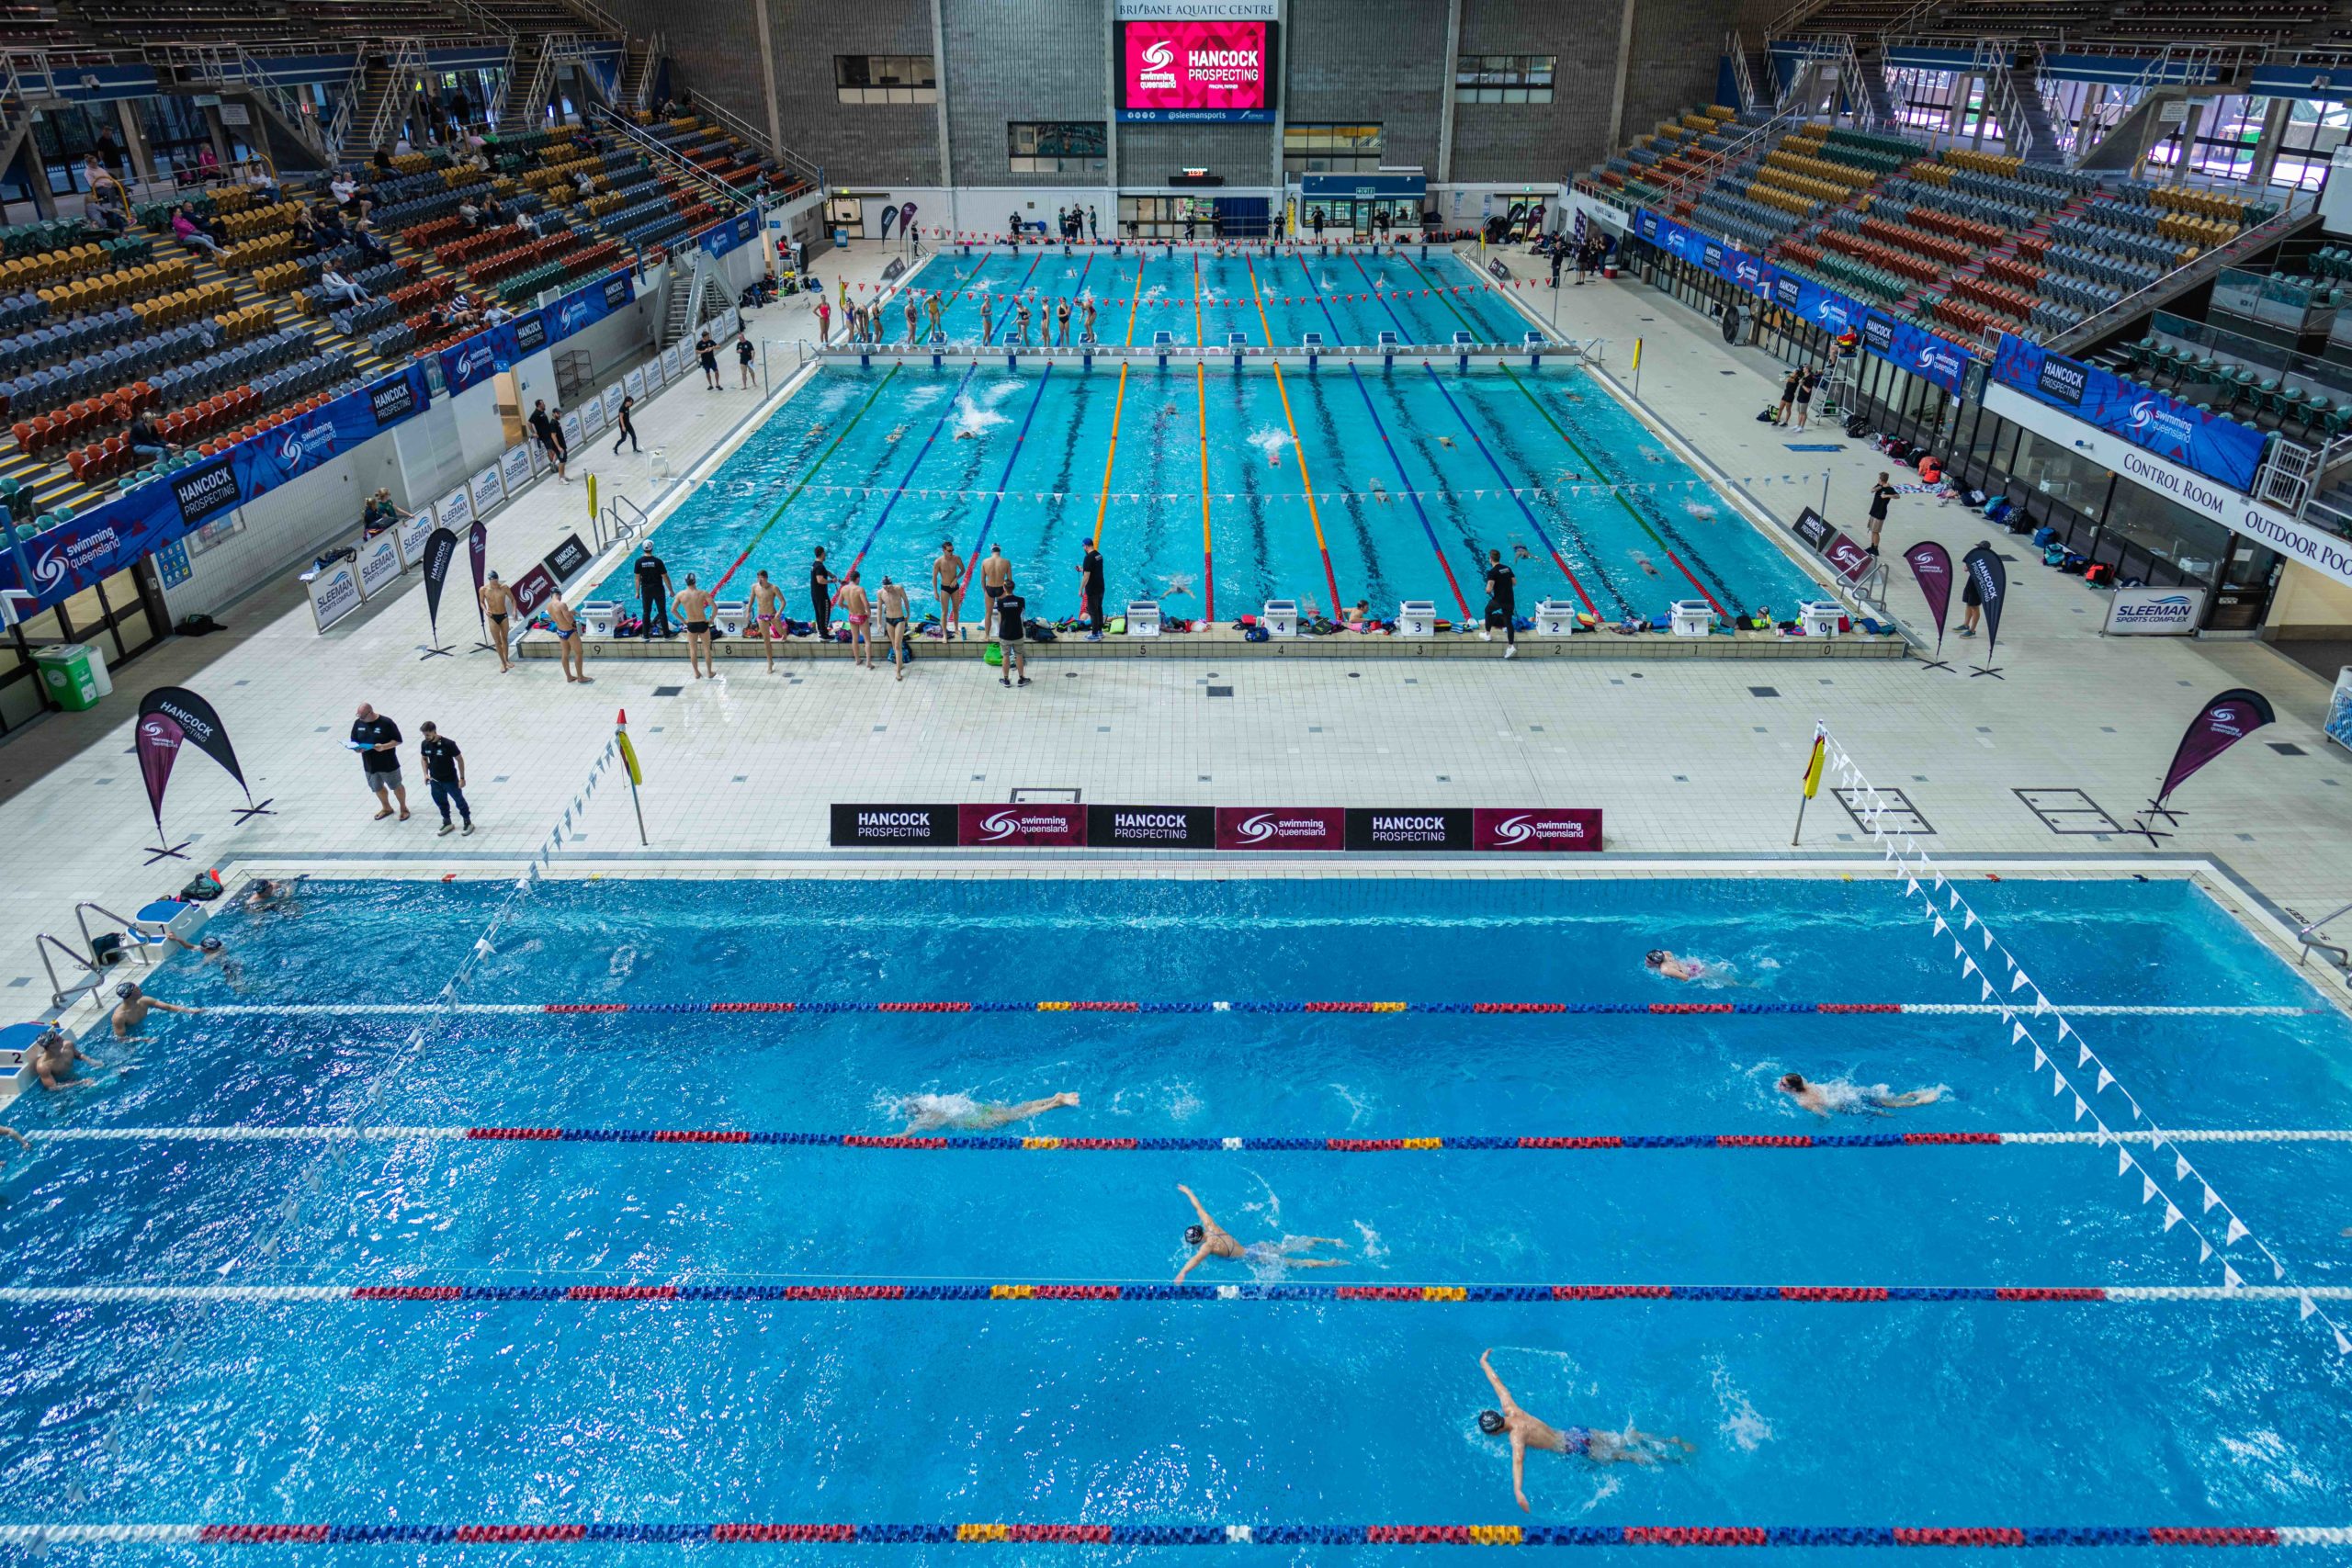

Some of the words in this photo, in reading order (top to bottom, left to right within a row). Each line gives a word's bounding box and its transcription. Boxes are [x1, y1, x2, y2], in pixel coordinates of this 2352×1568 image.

[1176, 5, 1226, 17] AQUATIC
[1226, 5, 1274, 15] CENTRE
[1188, 50, 1259, 67] HANCOCK
[1140, 71, 1175, 82] swimming
[1189, 69, 1259, 81] PROSPECTING
[1140, 79, 1176, 90] queensland
[1168, 111, 1227, 120] @sleemansports
[1779, 279, 1799, 296] HANCOCK
[516, 320, 542, 339] HANCOCK
[1866, 319, 1893, 340] HANCOCK
[1935, 353, 1960, 370] swimming
[2044, 361, 2084, 389] HANCOCK
[2041, 375, 2080, 400] PROSPECTING
[373, 383, 409, 409] HANCOCK
[378, 397, 412, 420] PROSPECTING
[2155, 410, 2193, 434] swimming
[301, 421, 334, 442] swimming
[2152, 421, 2192, 444] queensland
[304, 428, 337, 453] queensland
[505, 457, 528, 478] SLEEMAN
[177, 467, 232, 503] HANCOCK
[2123, 453, 2180, 493] CONTROL
[2182, 479, 2224, 514] ROOM
[475, 479, 500, 502] SLEEMAN
[184, 483, 236, 516] PROSPECTING
[441, 501, 468, 525] SLEEMAN
[67, 526, 115, 557] swimming
[403, 523, 433, 549] SLEEMAN
[2245, 511, 2318, 560] OUTDOOR
[2319, 546, 2352, 576] POO
[70, 536, 120, 570] queensland
[554, 543, 578, 566] HANCOCK
[362, 549, 395, 579] SLEEMAN
[430, 540, 447, 580] HANCOCK
[364, 570, 379, 585] SPORTS
[379, 559, 396, 579] COMPLEX
[1971, 561, 1991, 603] PROSPECTING
[1976, 558, 1997, 600] HANCOCK
[317, 577, 353, 609] SLEEMAN
[320, 600, 337, 616] SPORTS
[336, 588, 355, 605] COMPLEX
[2117, 605, 2192, 615] SLEEMAN
[598, 622, 605, 632] 9
[728, 622, 735, 632] 8
[1277, 622, 1284, 632] 4
[1415, 622, 1421, 632] 3
[1552, 622, 1559, 632] 2
[1690, 622, 1694, 632] 1
[1819, 622, 1826, 632] 0
[594, 645, 601, 655] 9
[726, 645, 731, 655] 8
[1140, 645, 1147, 655] 5
[1278, 645, 1283, 655] 4
[1417, 645, 1423, 655] 3
[1555, 645, 1561, 655] 2
[1824, 645, 1831, 655] 0
[160, 701, 214, 738] HANCOCK
[858, 813, 930, 826] HANCOCK
[1021, 816, 1066, 827] swimming
[1115, 814, 1186, 828] HANCOCK
[1279, 818, 1324, 829] swimming
[1373, 817, 1444, 829] HANCOCK
[1536, 820, 1582, 831] swimming
[858, 828, 931, 837] PROSPECTING
[1021, 824, 1068, 835] queensland
[1114, 829, 1187, 839] PROSPECTING
[1278, 827, 1326, 838] queensland
[1373, 831, 1445, 841] PROSPECTING
[1535, 829, 1584, 840] queensland
[157, 923, 165, 934] 1
[12, 1052, 23, 1064] 2
